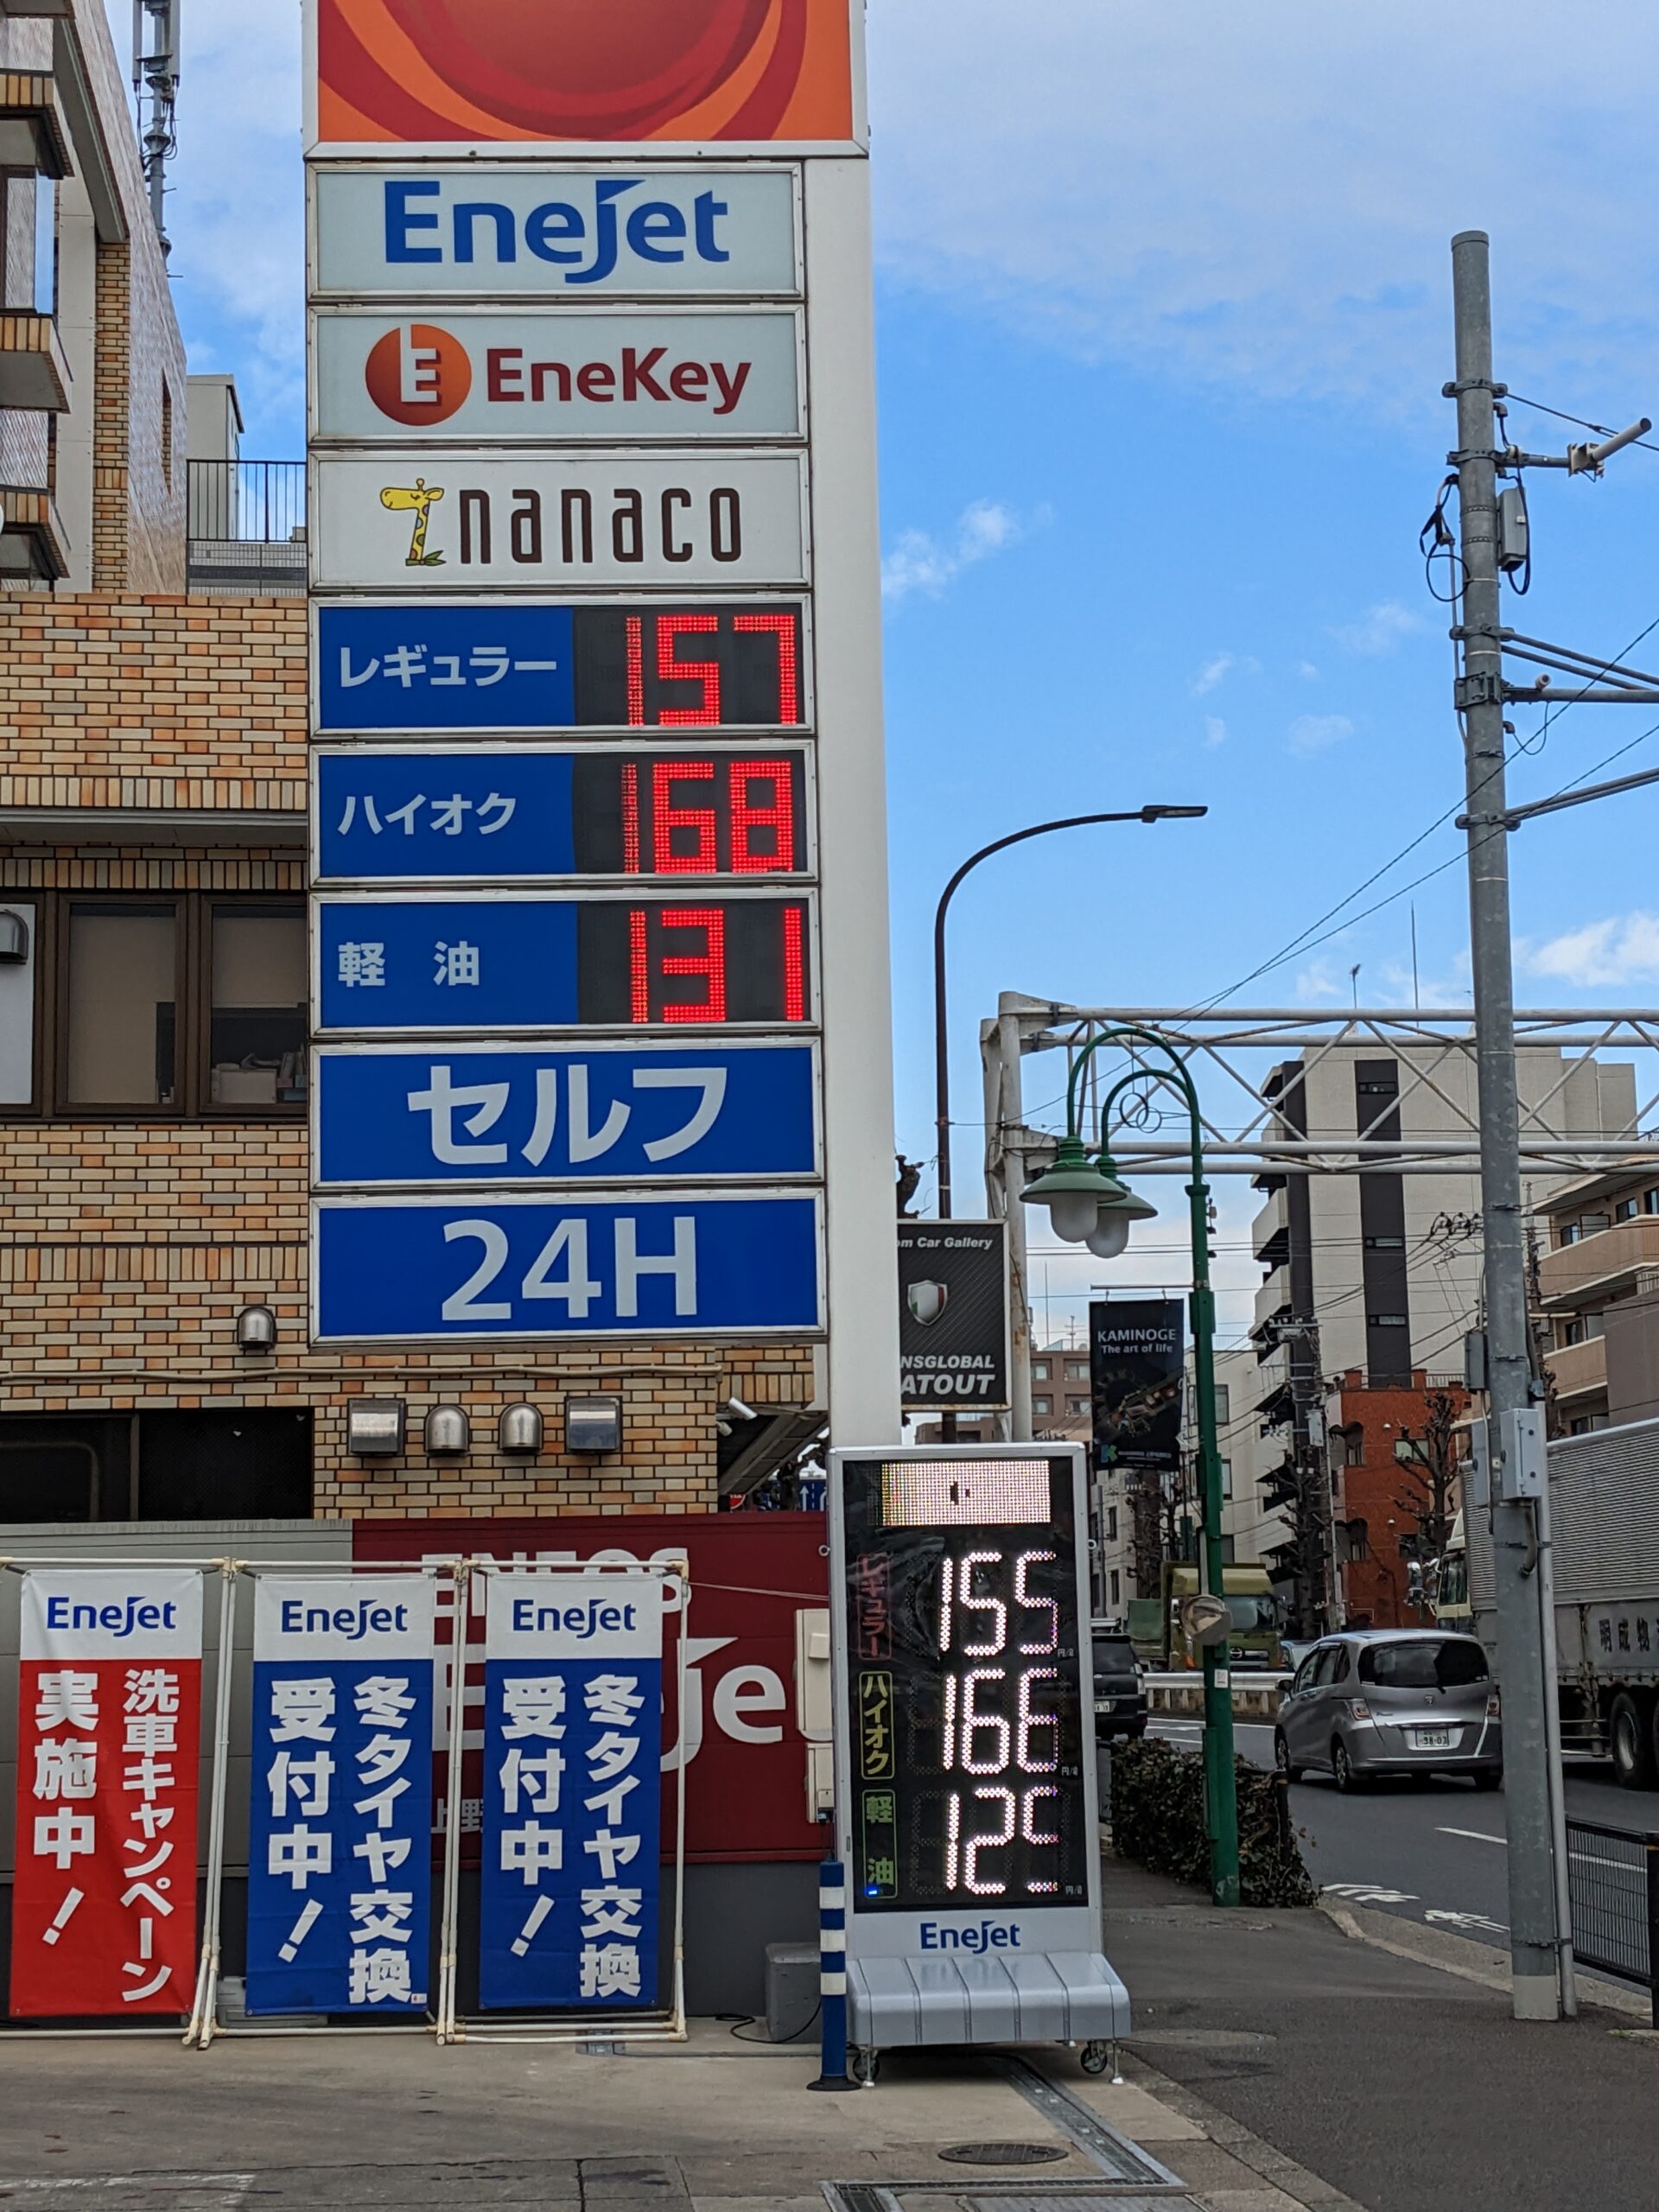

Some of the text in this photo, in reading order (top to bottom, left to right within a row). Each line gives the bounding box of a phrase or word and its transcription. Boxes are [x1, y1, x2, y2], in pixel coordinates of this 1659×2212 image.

[486, 346, 752, 415] EneKey
[459, 487, 741, 564] nanaco
[340, 645, 557, 688] レギュラー
[625, 614, 797, 730] 157
[338, 792, 518, 836] ハイオク
[620, 760, 794, 874] 168
[629, 907, 804, 1022] 131
[407, 1065, 728, 1166] セルフ
[441, 1216, 698, 1321] 24H
[917, 1236, 941, 1248] Car
[944, 1236, 993, 1250] Gallery
[1096, 1328, 1177, 1343] KAMINOGE
[1101, 1343, 1173, 1354] The art of life
[863, 1675, 891, 1776] ハイオク
[121, 1669, 180, 2002] 洗車キャンペーン
[348, 1676, 417, 2004] 冬タイヤ交換
[580, 1674, 646, 1998] 冬タイヤ交換
